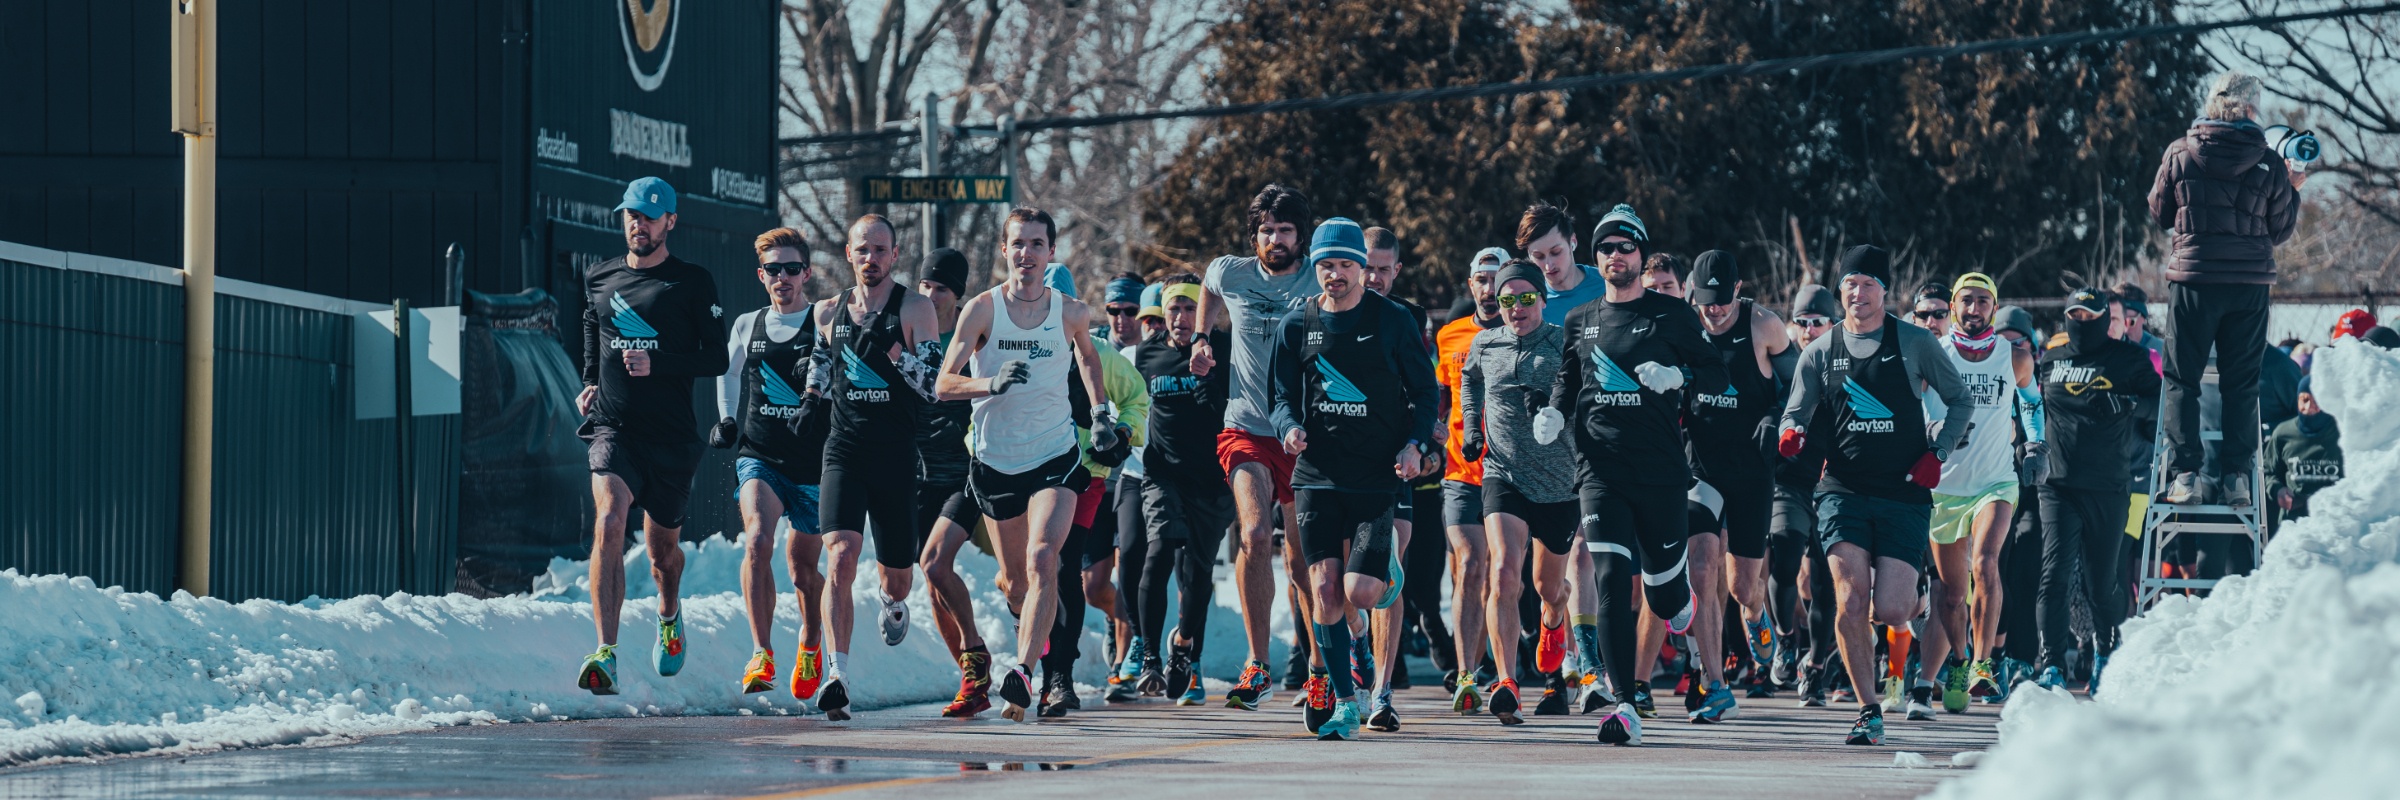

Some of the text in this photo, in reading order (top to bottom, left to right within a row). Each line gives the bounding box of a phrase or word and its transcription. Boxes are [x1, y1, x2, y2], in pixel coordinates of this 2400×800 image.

[610, 108, 691, 168] BASEBALL
[869, 179, 1006, 199] TIM ENGLEKA WAY
[836, 325, 850, 333] DTC
[1585, 326, 1600, 335] DTC
[1308, 331, 1323, 340] DTC
[611, 336, 658, 350] dayton
[752, 340, 766, 349] DTC
[998, 339, 1039, 351] RUNNERS
[1028, 347, 1053, 360] Elite
[1833, 358, 1849, 367] DTC
[2053, 360, 2073, 368] TEAM
[1961, 373, 1988, 384] HT TO
[846, 389, 890, 401] dayton
[1967, 384, 1995, 395] MENT
[1594, 391, 1641, 406] dayton
[1972, 395, 1993, 405] TINE
[1318, 401, 1367, 415] dayton
[1847, 418, 1894, 434] dayton
[1296, 511, 1319, 527] ep
